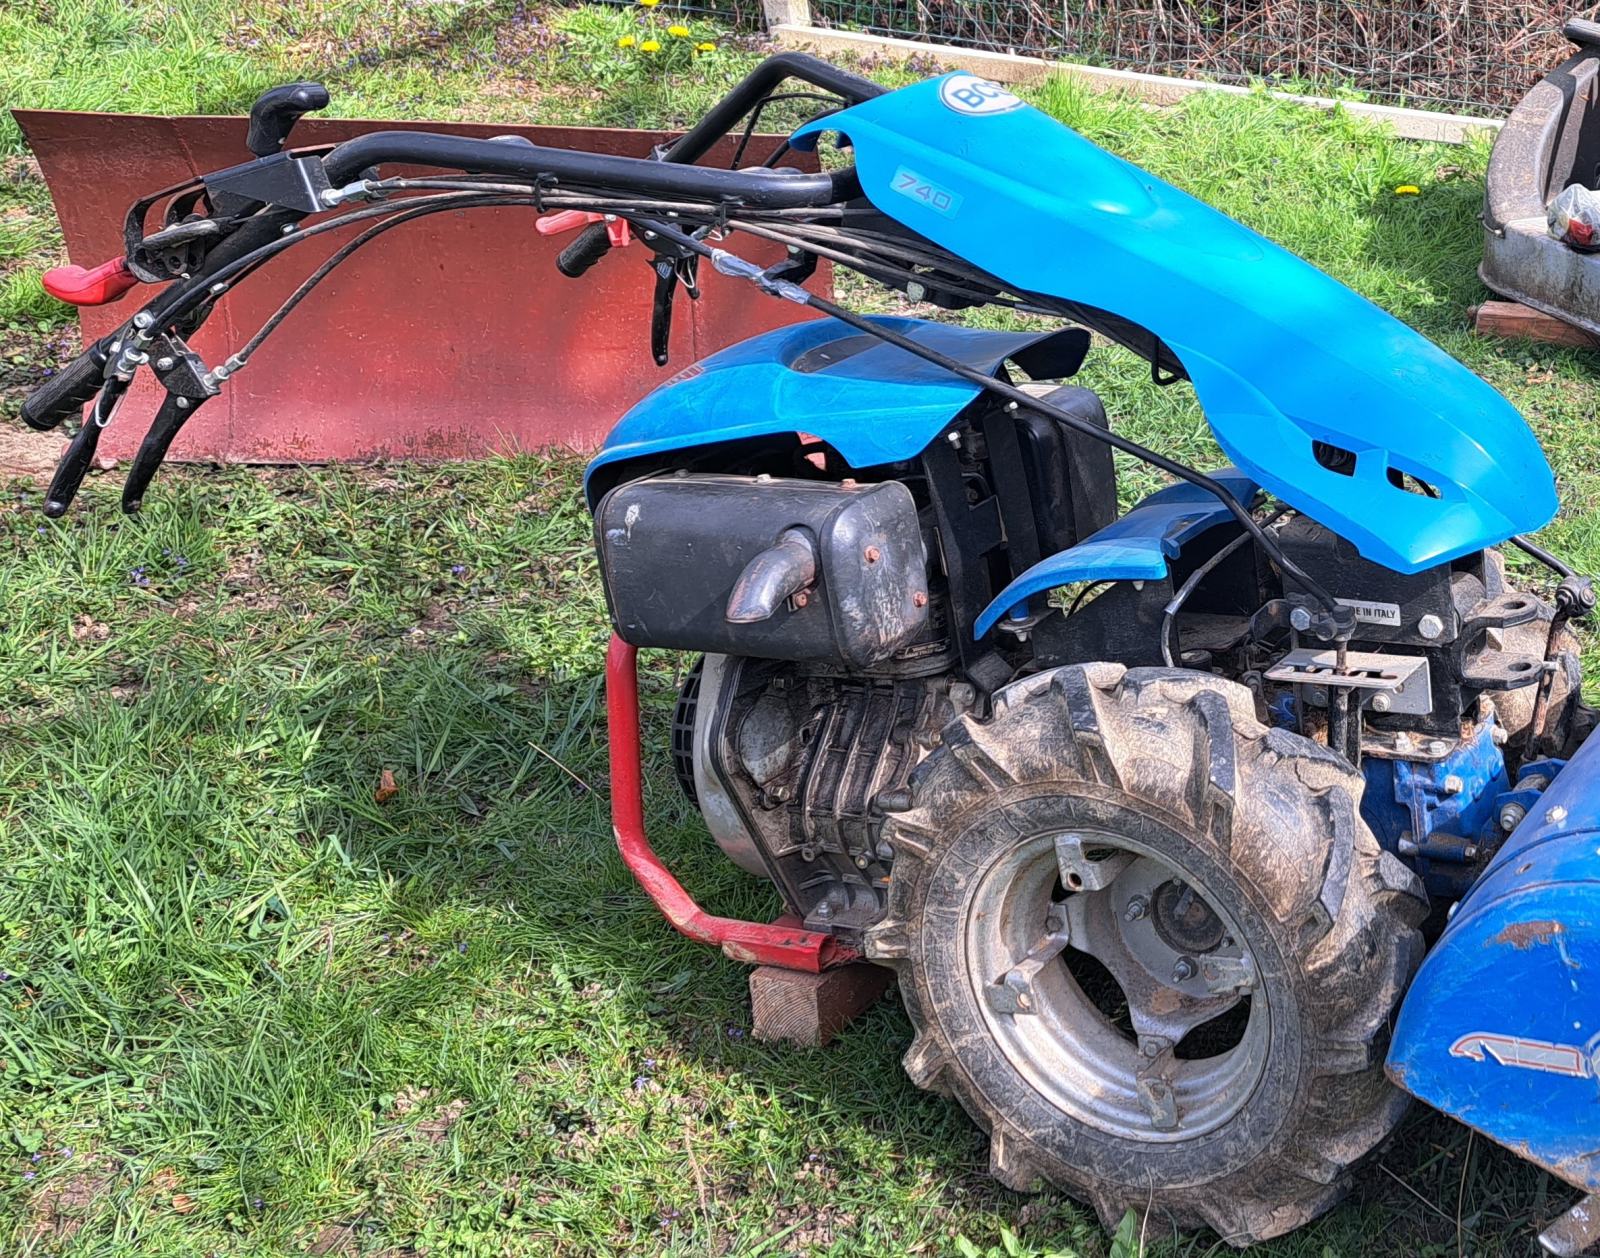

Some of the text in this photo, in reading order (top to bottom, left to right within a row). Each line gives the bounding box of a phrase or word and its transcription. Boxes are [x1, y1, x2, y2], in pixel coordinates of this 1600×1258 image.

[898, 172, 952, 210] 740
[1363, 607, 1372, 617] IN
[1374, 608, 1396, 619] ITALY
